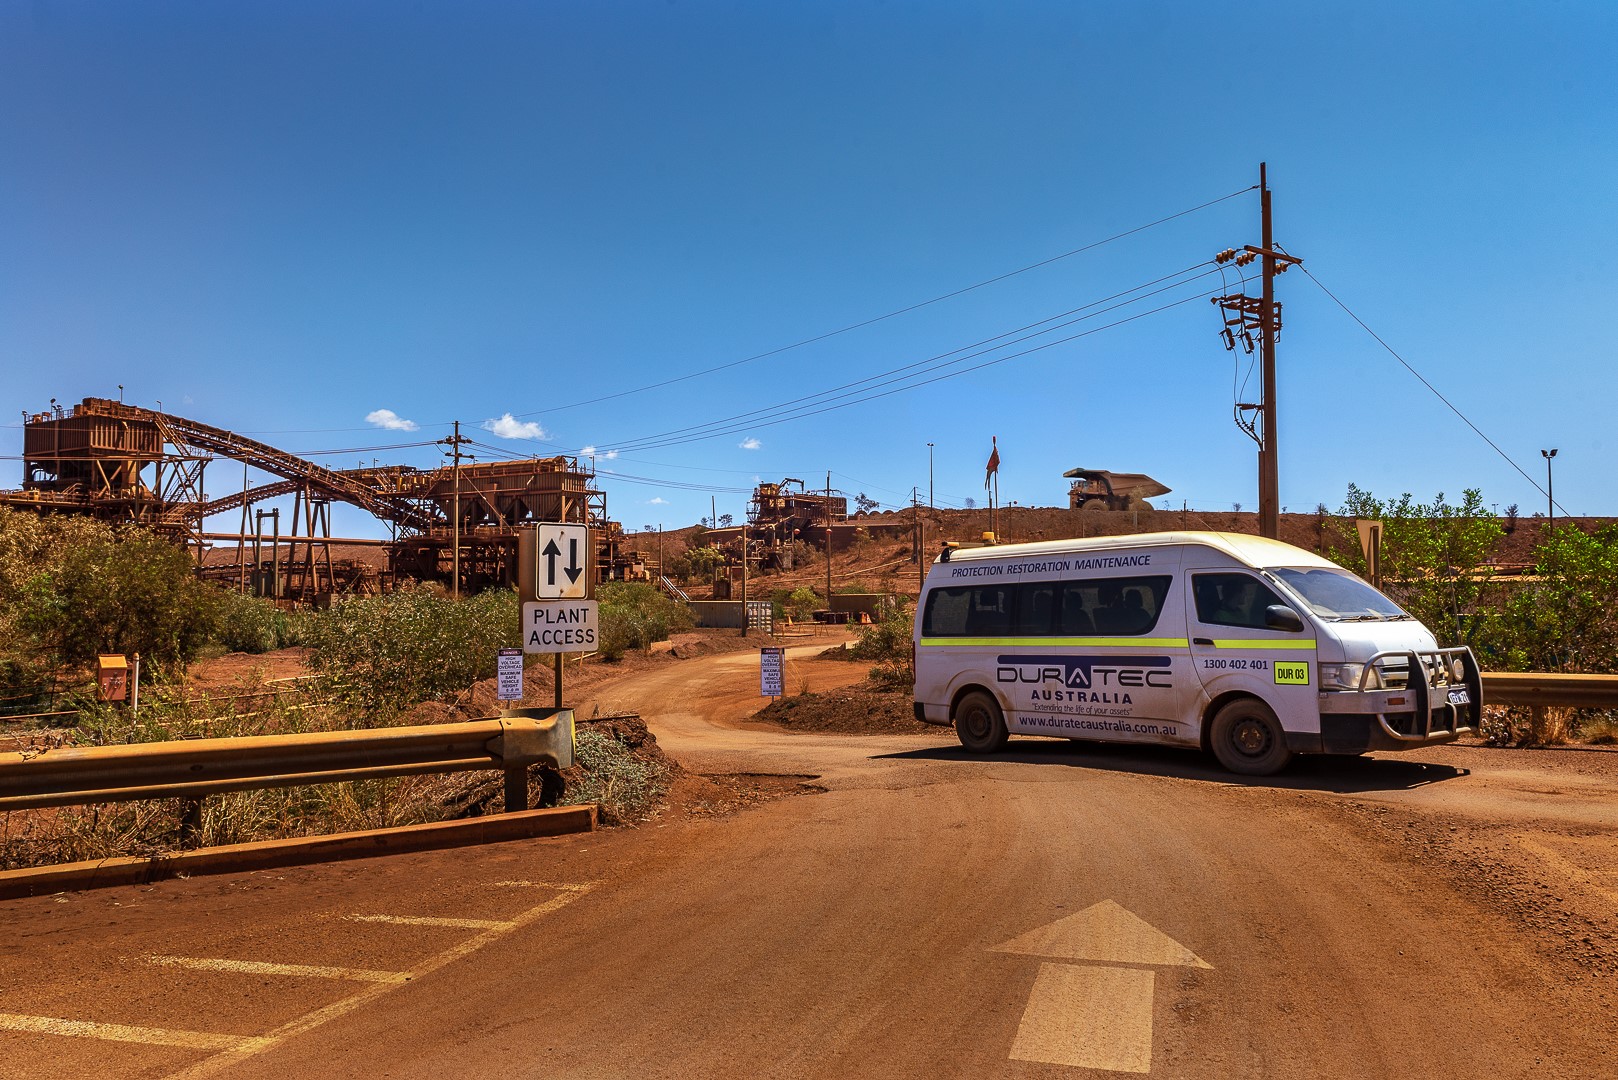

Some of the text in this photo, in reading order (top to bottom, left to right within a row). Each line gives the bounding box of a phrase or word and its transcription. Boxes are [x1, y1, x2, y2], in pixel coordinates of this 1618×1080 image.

[951, 555, 1151, 577] PROTECTION RESTORATION MAINTENANCE
[534, 608, 589, 624] PLANT
[529, 629, 594, 645] ACCESS
[1204, 660, 1268, 670] 1300 402 401
[997, 666, 1172, 688] DURATEC
[1278, 668, 1304, 679] DUR 03
[1031, 690, 1132, 704] AUSTRALIA
[1076, 706, 1085, 714] life
[1085, 706, 1093, 714] of
[1093, 708, 1107, 716] your
[1019, 716, 1177, 736] www.duratecaustralia.com.au
